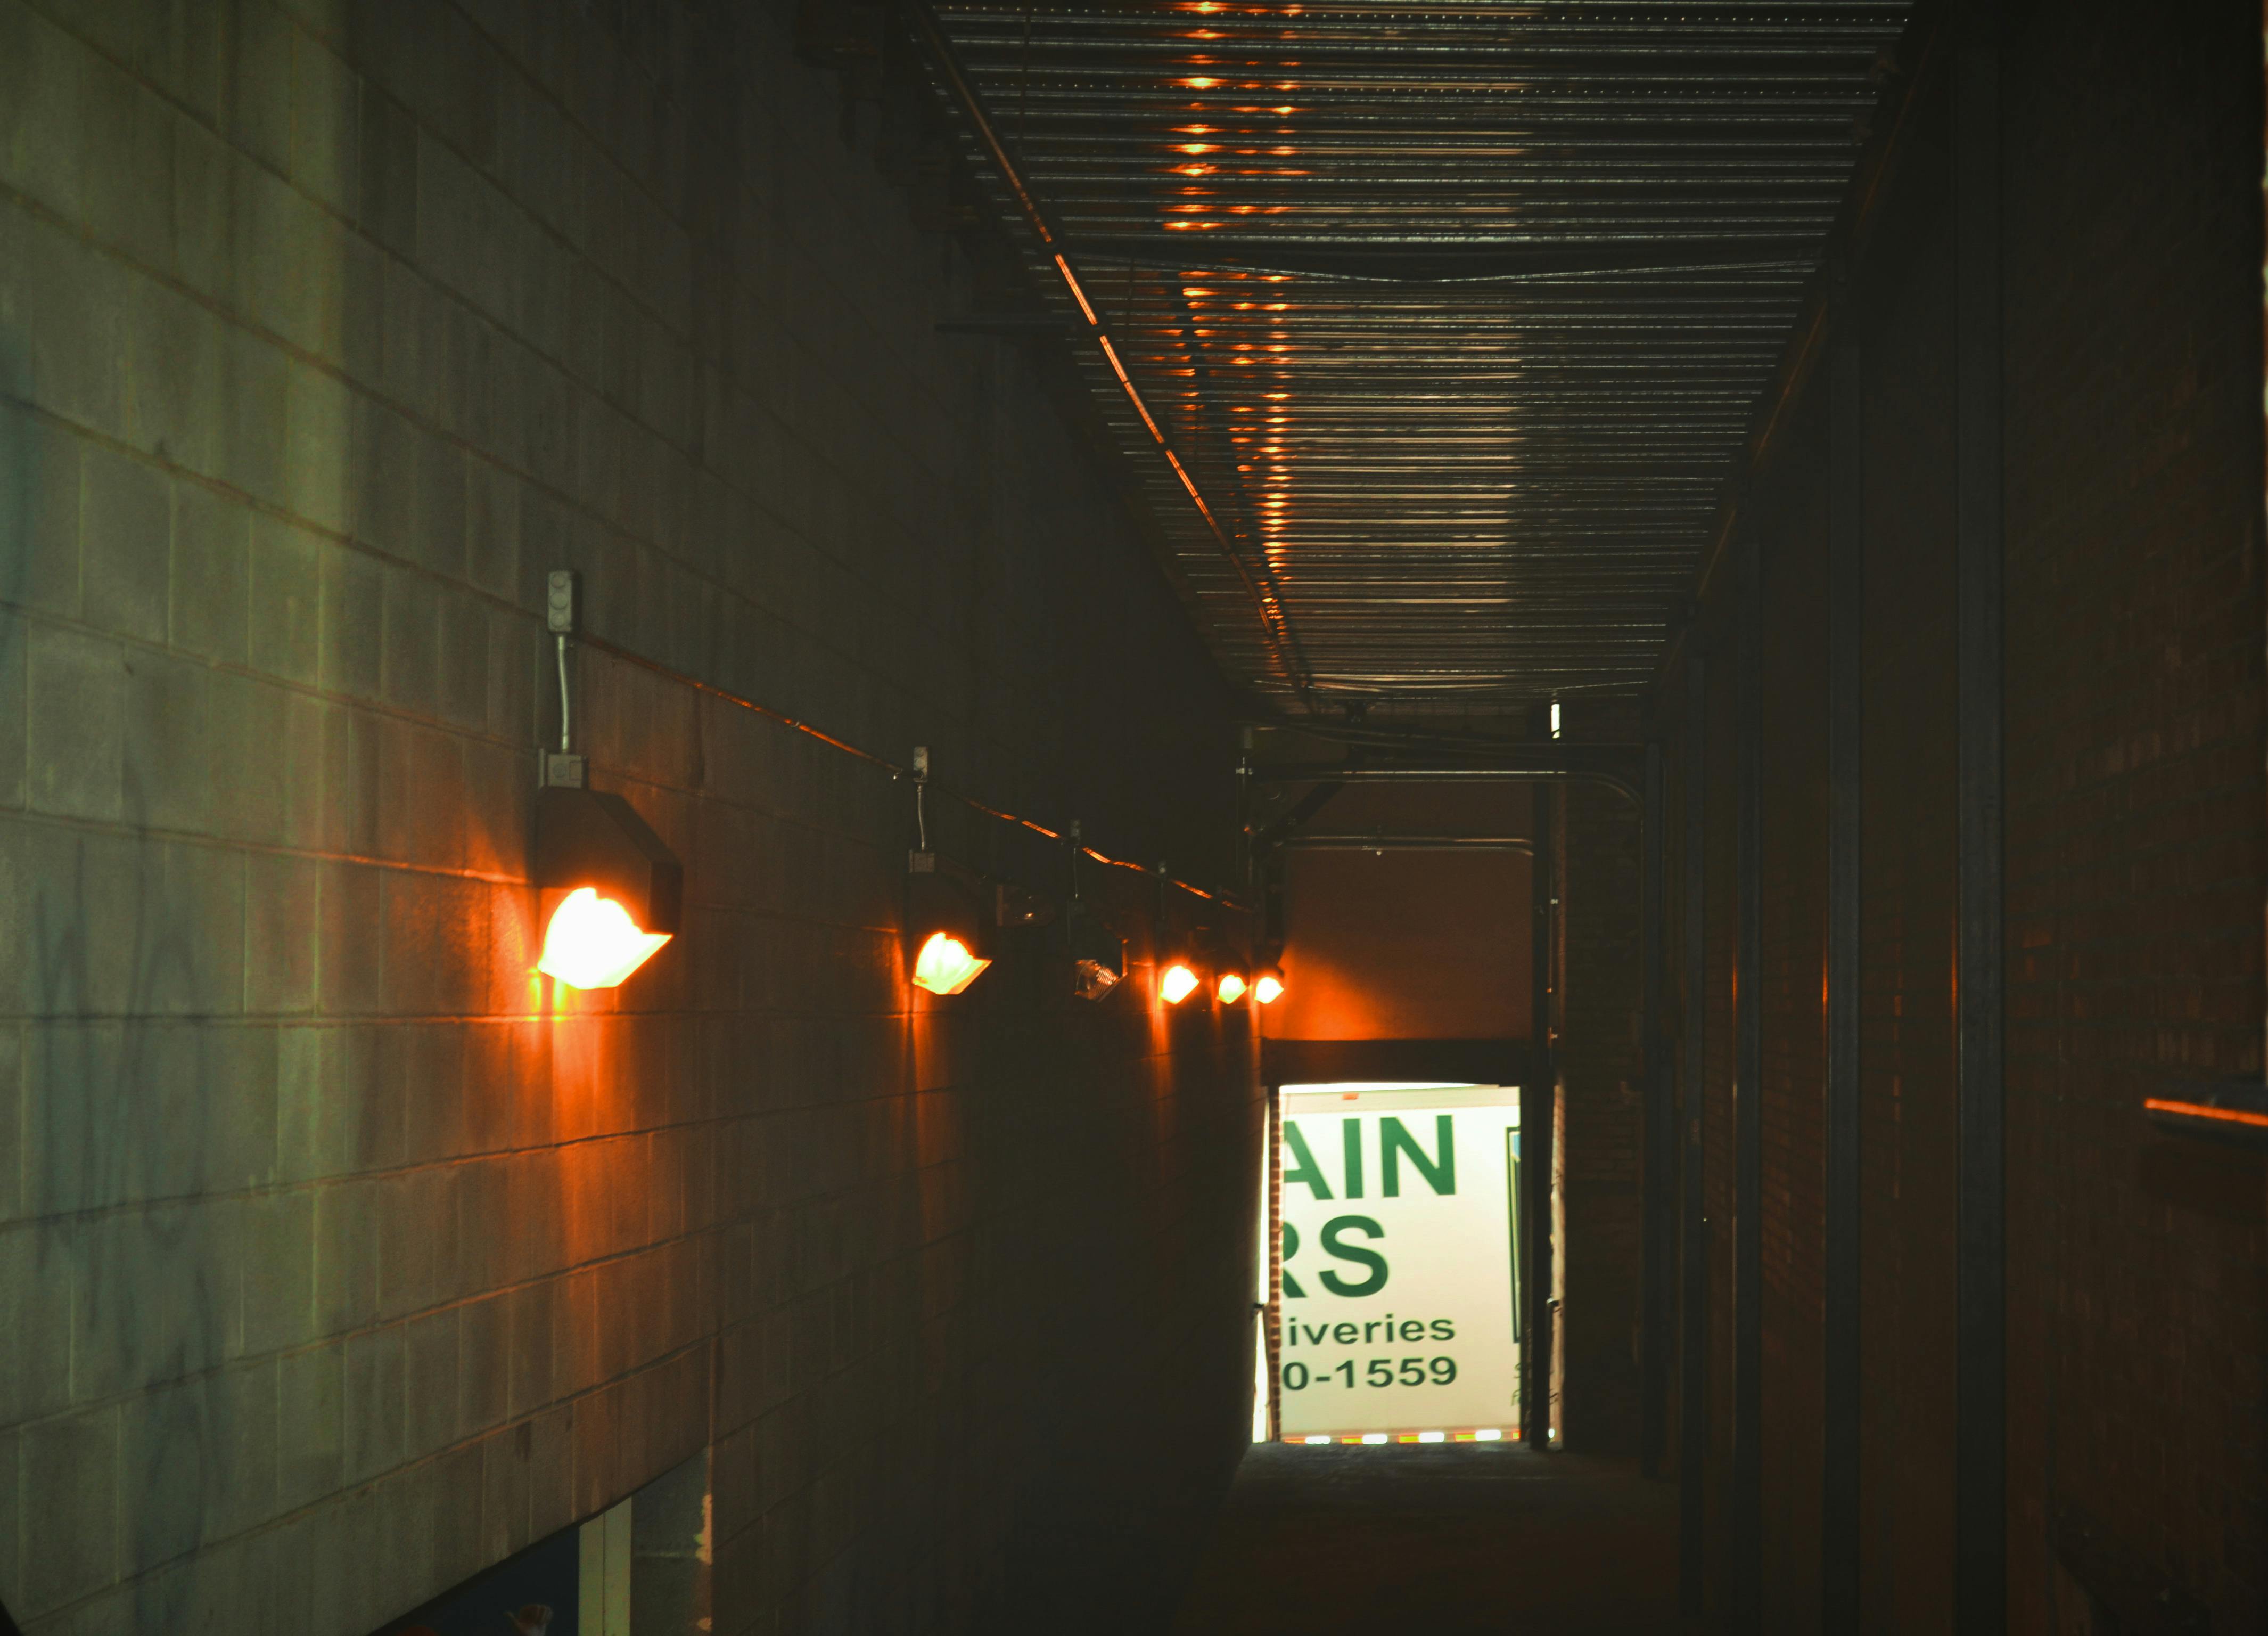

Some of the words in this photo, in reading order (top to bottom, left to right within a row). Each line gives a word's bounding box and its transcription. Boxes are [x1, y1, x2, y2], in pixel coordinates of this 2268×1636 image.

[1283, 1115, 1456, 1200] AIN
[1289, 1314, 1456, 1346] iveries
[1283, 1356, 1457, 1391] 0-1559
